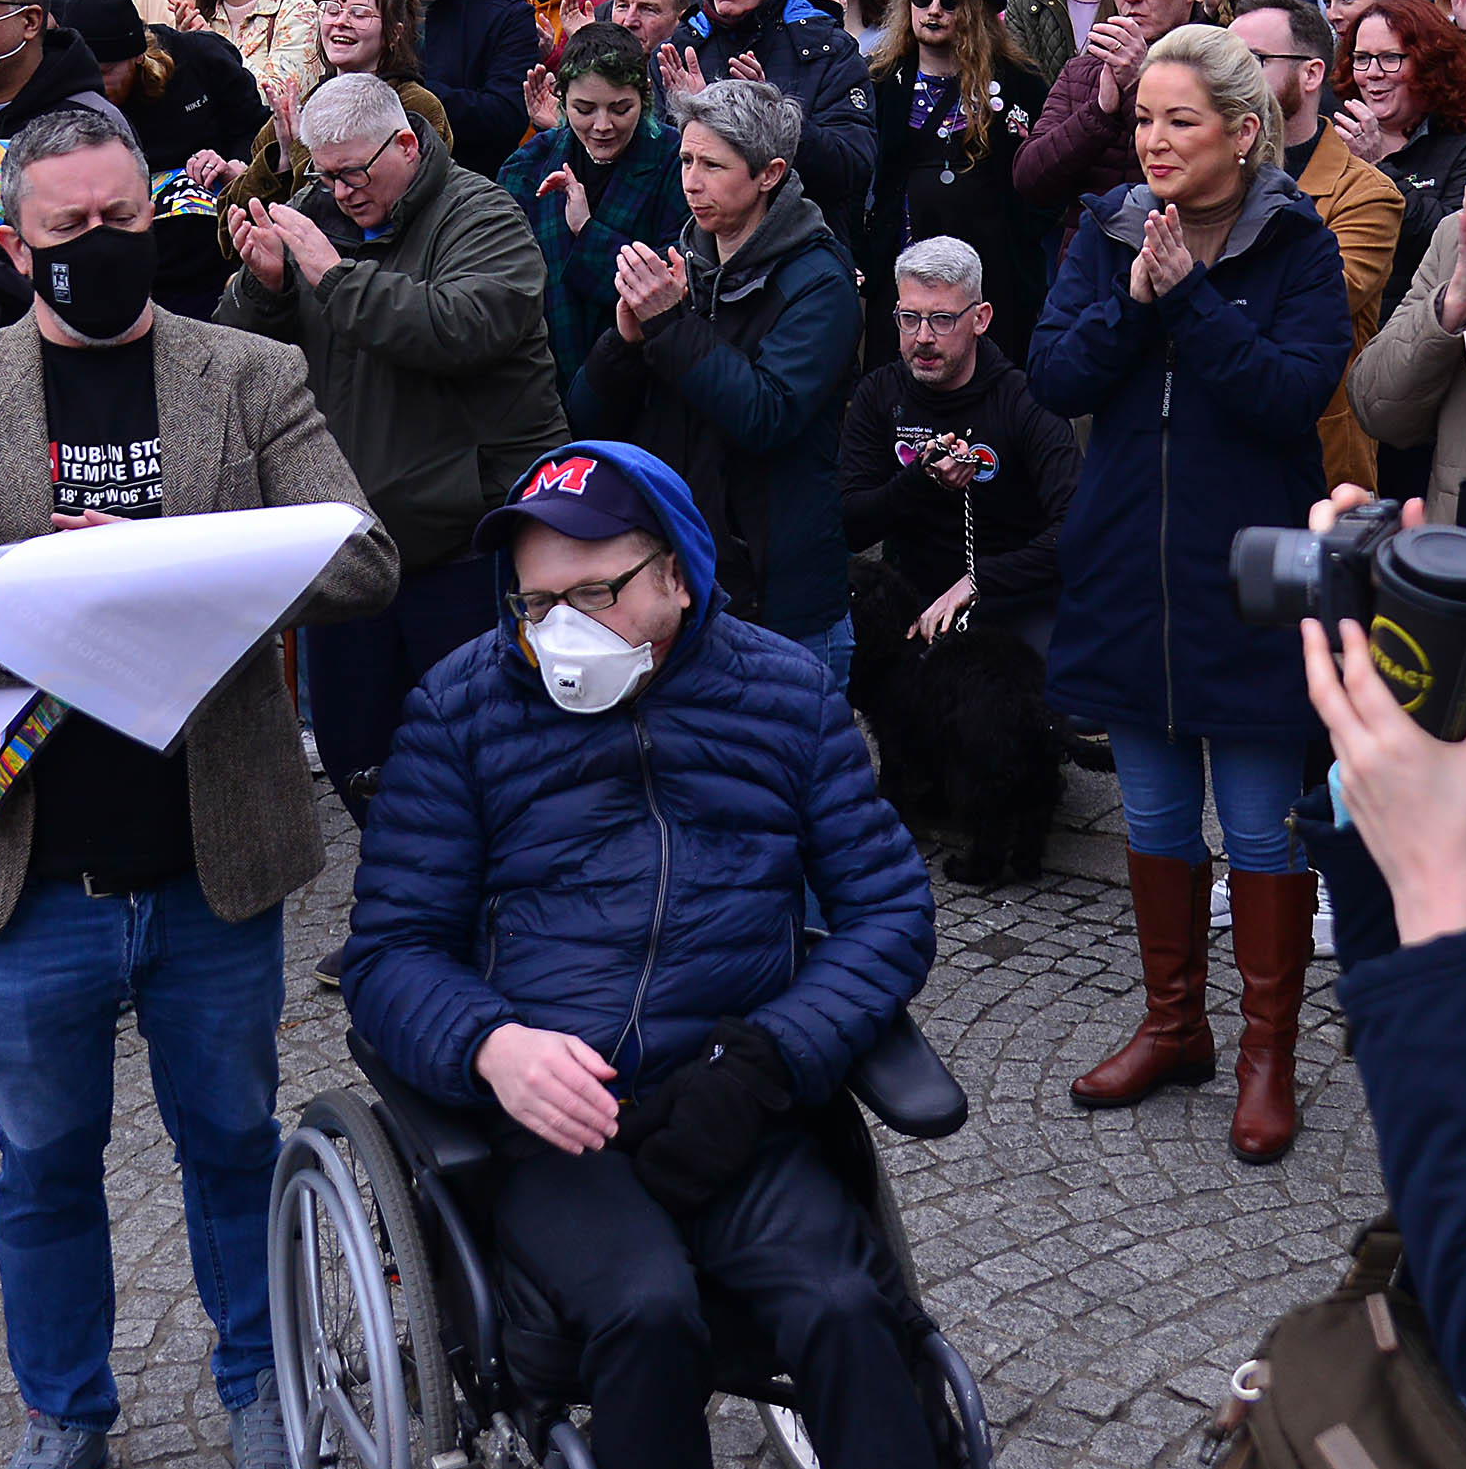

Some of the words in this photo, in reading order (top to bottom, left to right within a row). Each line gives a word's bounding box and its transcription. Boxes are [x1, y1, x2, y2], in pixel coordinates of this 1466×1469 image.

[185, 99, 202, 113] NIKE
[61, 443, 124, 463] DUBLIN
[61, 461, 128, 483] TEMPLE
[521, 456, 598, 501] M
